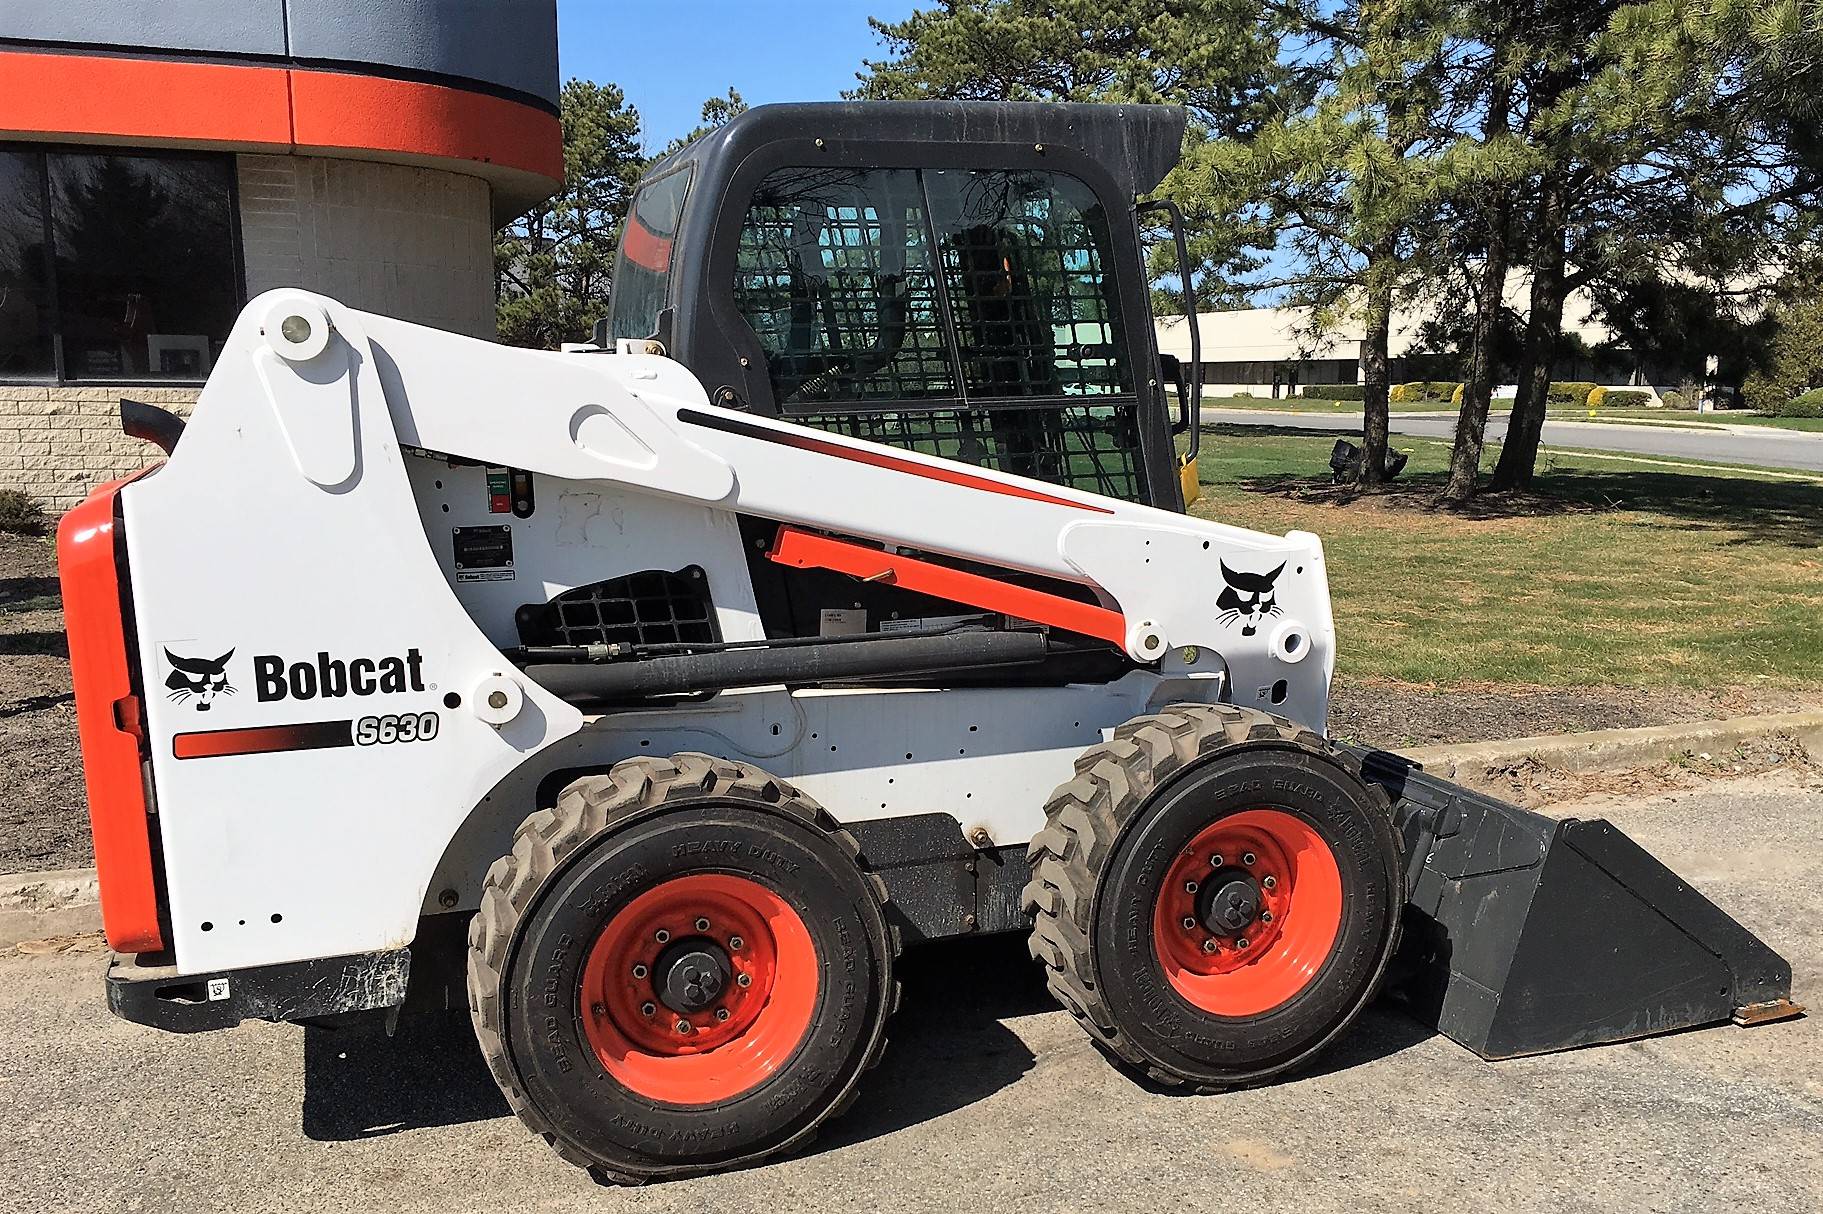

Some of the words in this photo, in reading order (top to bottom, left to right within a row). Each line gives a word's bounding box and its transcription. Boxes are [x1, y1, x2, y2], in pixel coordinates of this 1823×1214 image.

[254, 648, 425, 702] Bobcat
[357, 711, 440, 747] S630
[671, 839, 743, 858] HEAVY
[747, 844, 801, 874] DUTY
